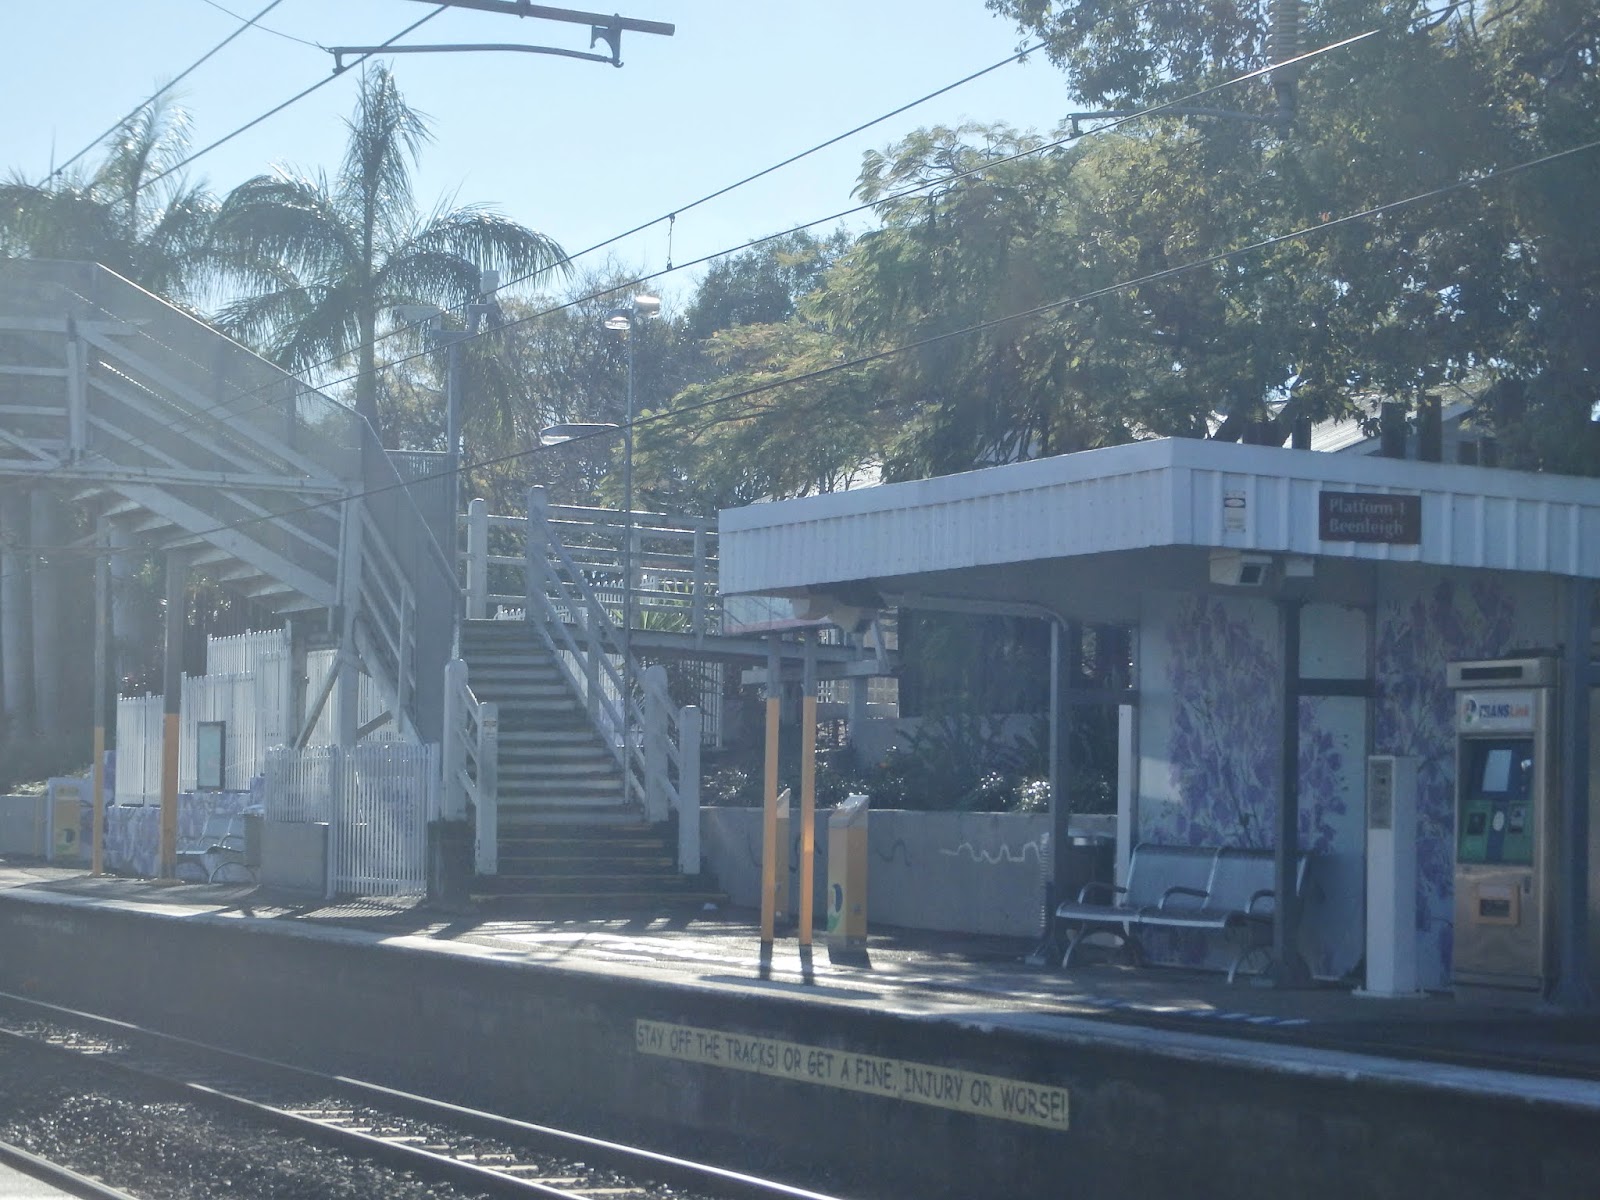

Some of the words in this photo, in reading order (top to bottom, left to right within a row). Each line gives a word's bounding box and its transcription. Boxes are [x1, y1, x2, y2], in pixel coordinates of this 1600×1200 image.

[1329, 498, 1393, 514] Platform
[1329, 518, 1404, 539] Beenleigh
[637, 1024, 664, 1049] STAY
[670, 1029, 692, 1054] OFF
[697, 1032, 720, 1060] THE
[784, 1046, 801, 1072] OR
[808, 1050, 834, 1078] GET
[841, 1057, 849, 1081] A
[904, 1067, 963, 1103] INJURY
[970, 1079, 993, 1108] OR
[1001, 1086, 1066, 1124] WORSE!
